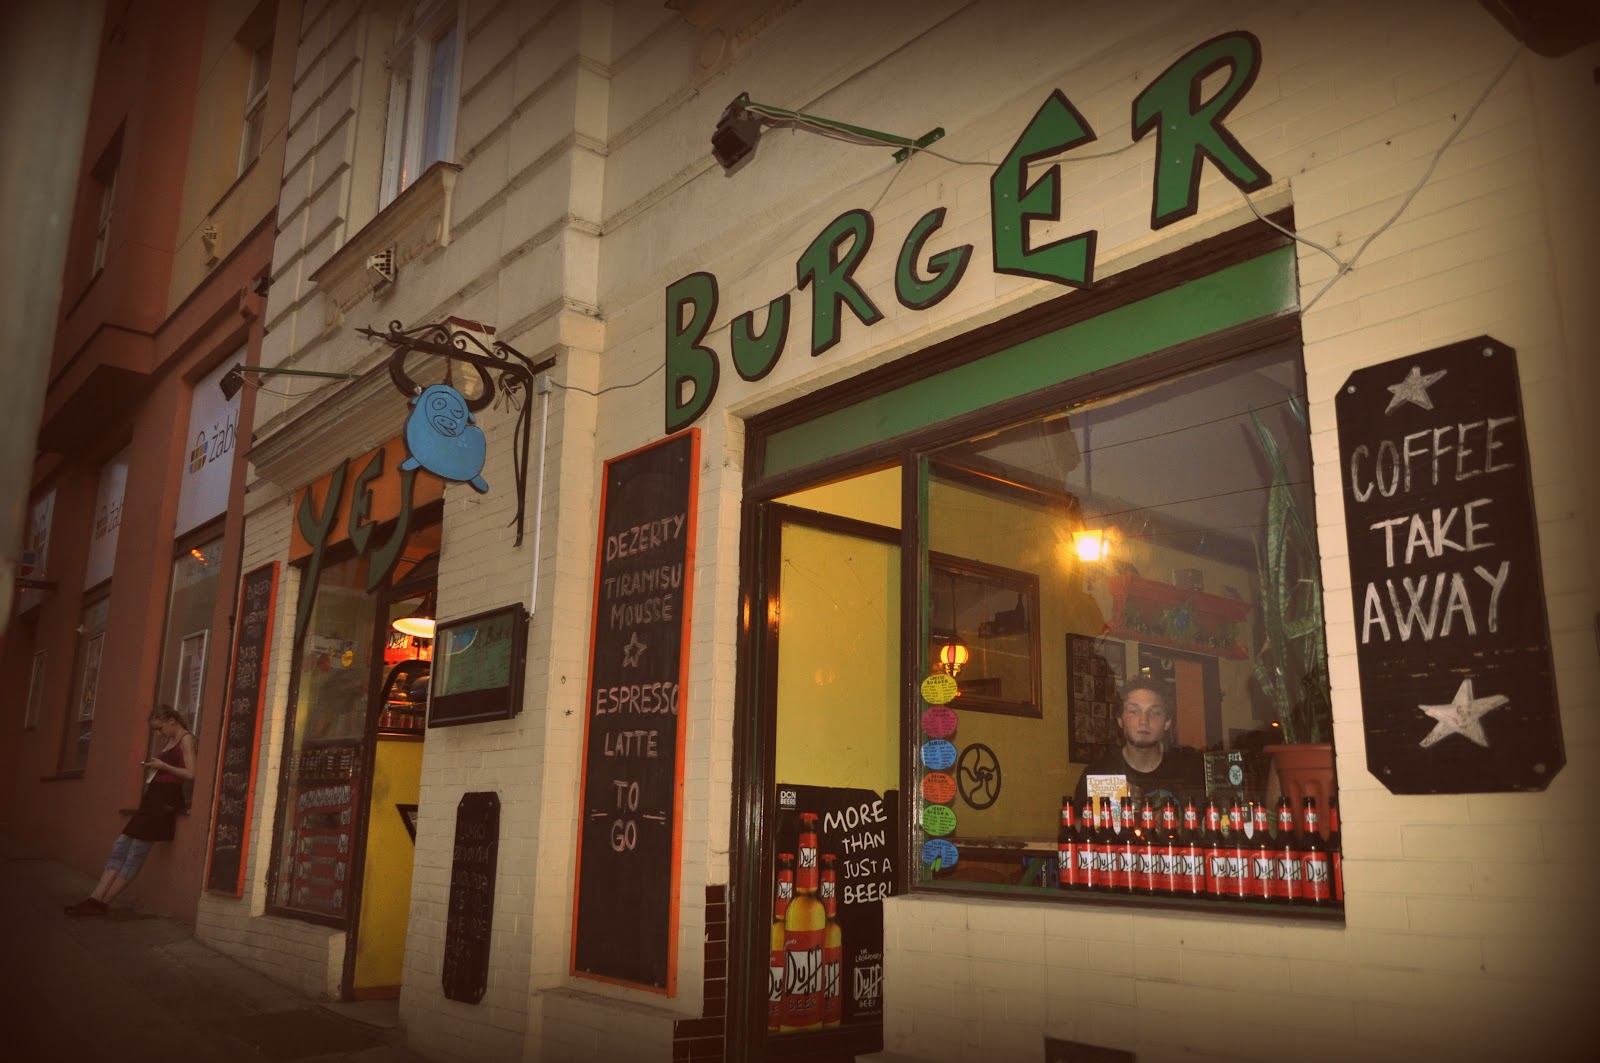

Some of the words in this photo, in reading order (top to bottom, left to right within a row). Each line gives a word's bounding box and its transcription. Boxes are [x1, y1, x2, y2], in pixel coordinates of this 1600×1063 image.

[665, 30, 1272, 434] BURGER
[1351, 416, 1518, 502] COFFEE
[606, 513, 686, 562] DEZERTY
[1370, 499, 1496, 567] TAKE
[604, 563, 682, 600] TIRAMISU
[610, 594, 672, 631] MOUSSE
[1362, 561, 1511, 643] AWAY
[596, 682, 679, 716] ESPRESSO
[604, 730, 659, 758] LATTE
[613, 780, 640, 812] TO
[780, 791, 797, 799] DCN
[823, 800, 888, 834] MORE
[611, 818, 638, 852] GO
[842, 830, 885, 855] THAN
[800, 848, 817, 868] Duff
[843, 858, 878, 879] JUST
[882, 857, 893, 874] A
[843, 881, 892, 905] BEER!
[785, 945, 822, 997] Duff
[853, 963, 883, 1000] Duff
